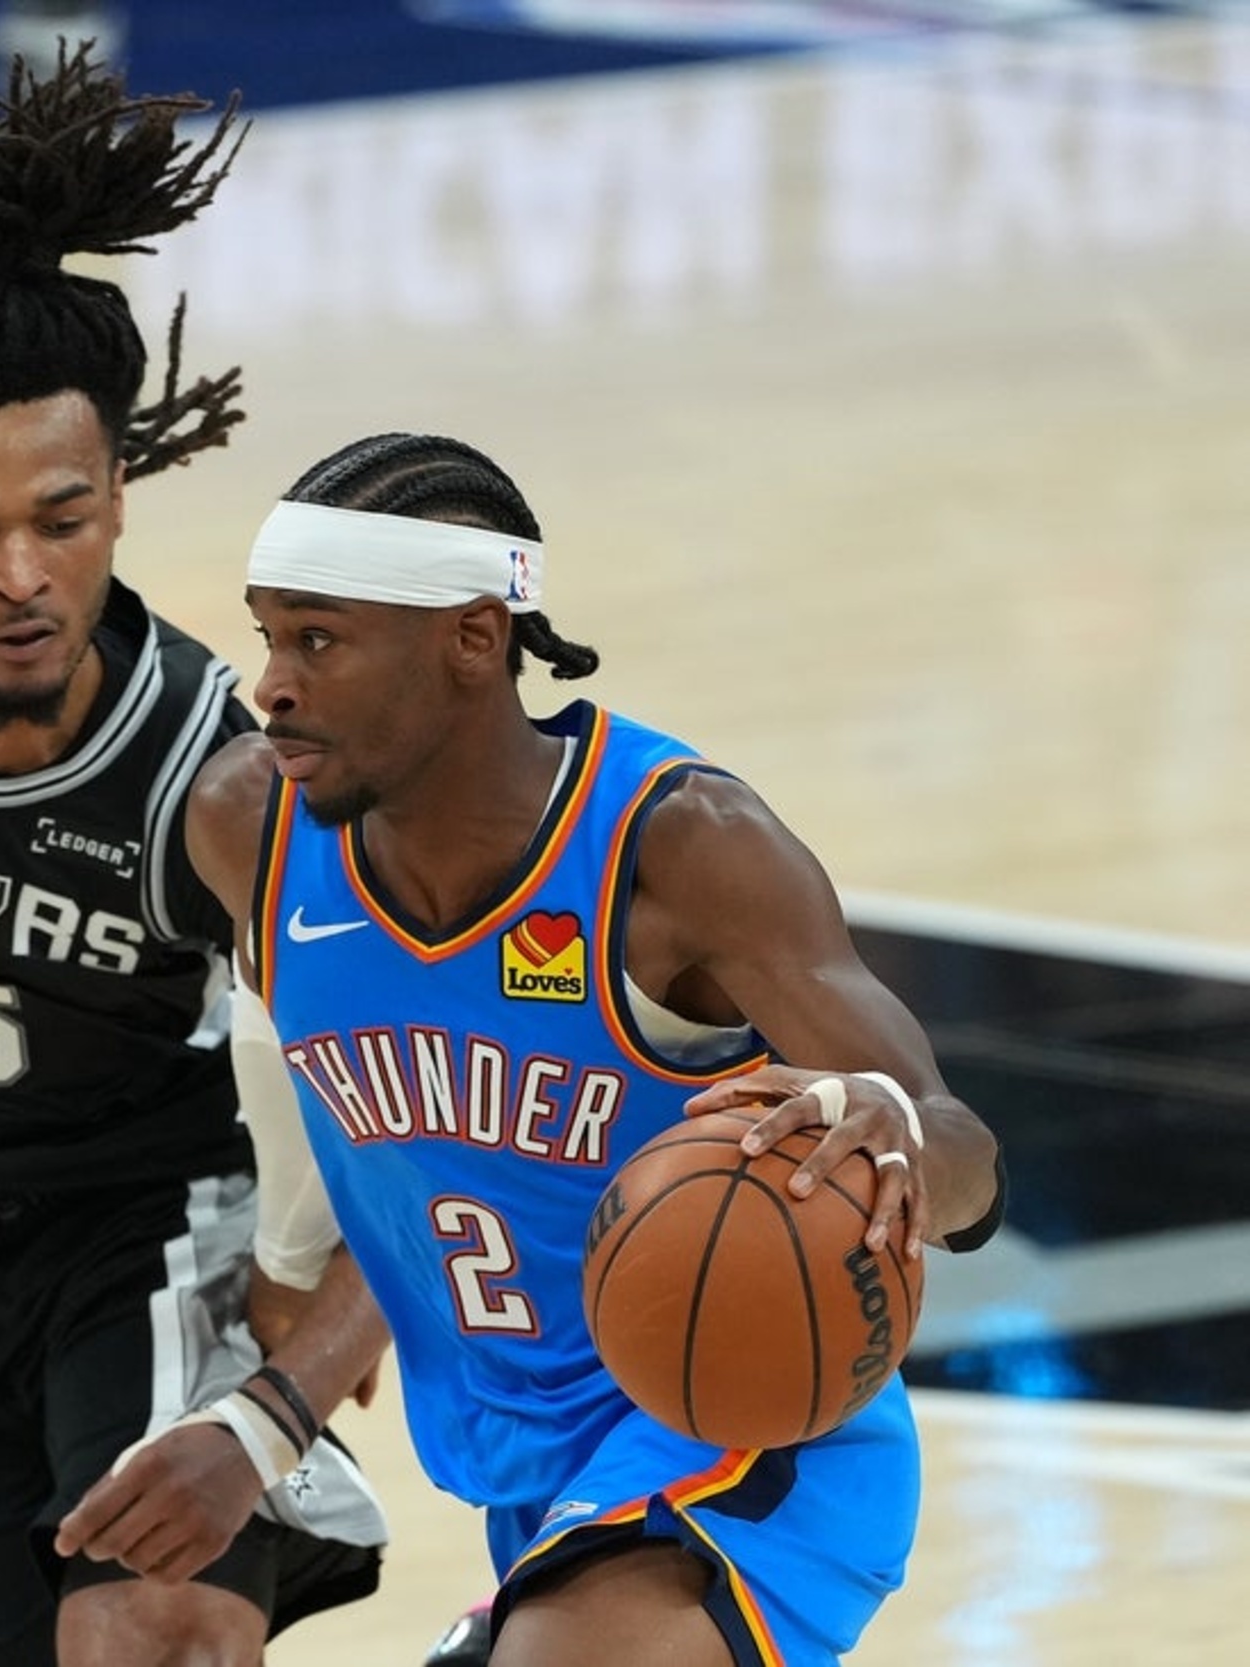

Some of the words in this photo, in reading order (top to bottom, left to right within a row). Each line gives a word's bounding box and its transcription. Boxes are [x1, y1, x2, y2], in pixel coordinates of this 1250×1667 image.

[48, 829, 125, 866] LEDGER
[284, 1024, 626, 1166] THUNDER
[431, 1196, 540, 1336] 2
